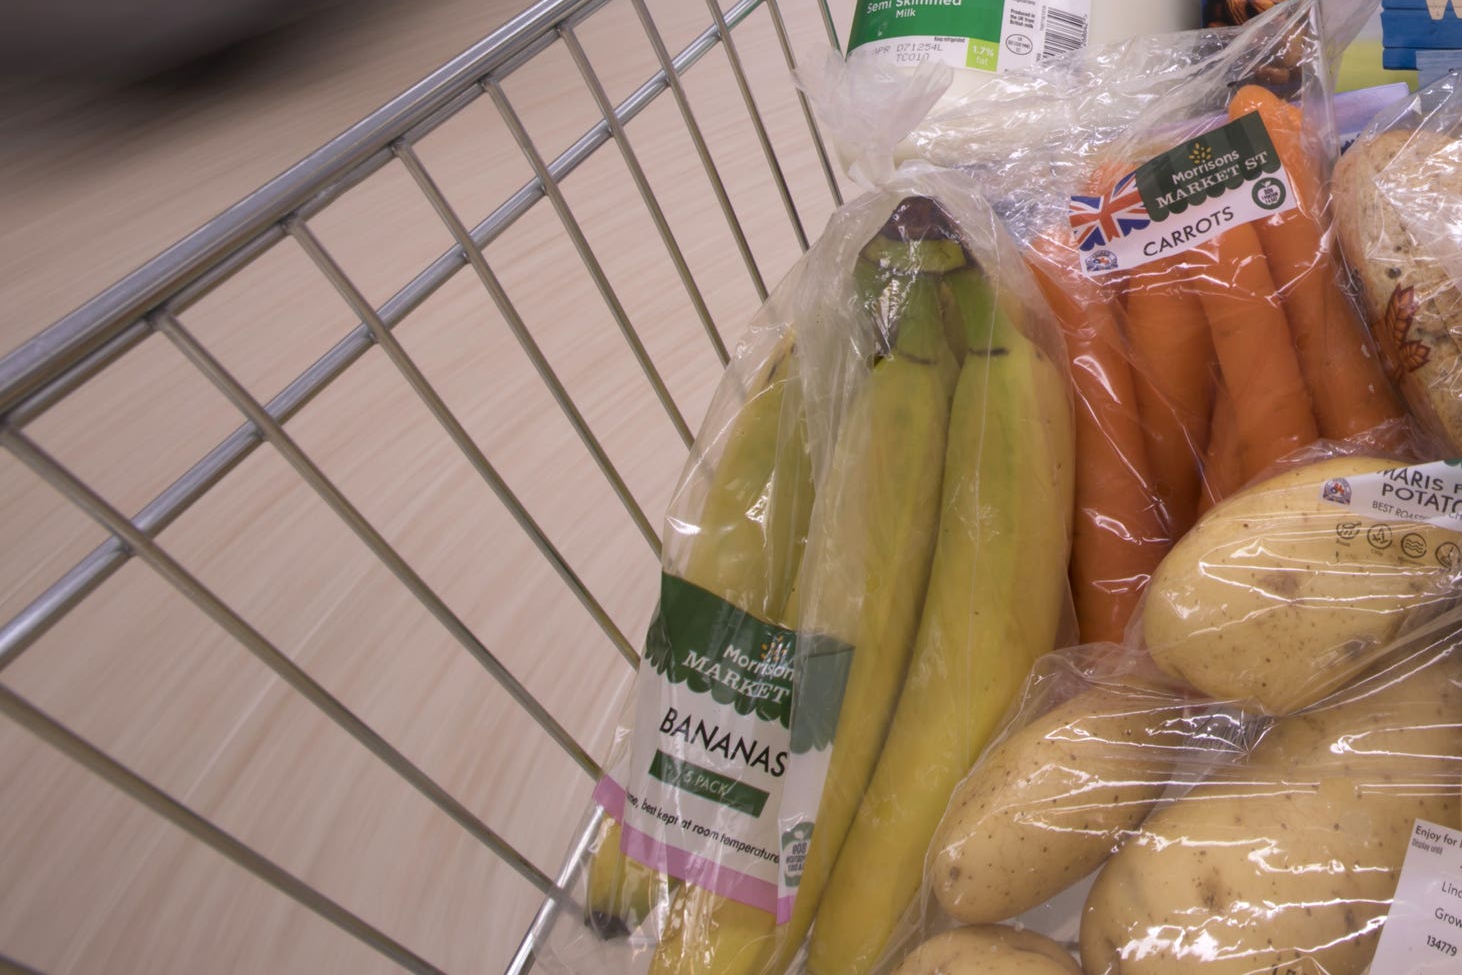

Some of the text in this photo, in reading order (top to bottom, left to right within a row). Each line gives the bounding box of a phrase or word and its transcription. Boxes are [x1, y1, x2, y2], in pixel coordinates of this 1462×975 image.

[896, 8, 916, 18] Milk
[976, 56, 988, 66] fat
[1155, 163, 1240, 209] MARKET
[1244, 151, 1268, 170] ST
[1171, 149, 1240, 185] Morrisons
[1143, 206, 1235, 257] CARROTS
[1372, 500, 1394, 514] BEST
[682, 649, 791, 704] MARKET
[659, 707, 789, 777] BANANAS
[695, 774, 729, 797] PACK
[641, 798, 658, 815] best
[657, 807, 680, 825] kept
[681, 819, 692, 830] at
[692, 824, 719, 841] room
[720, 833, 780, 864] temperature
[1415, 825, 1441, 842] Enjoy
[1443, 834, 1457, 846] for
[1426, 935, 1458, 957] 134779
